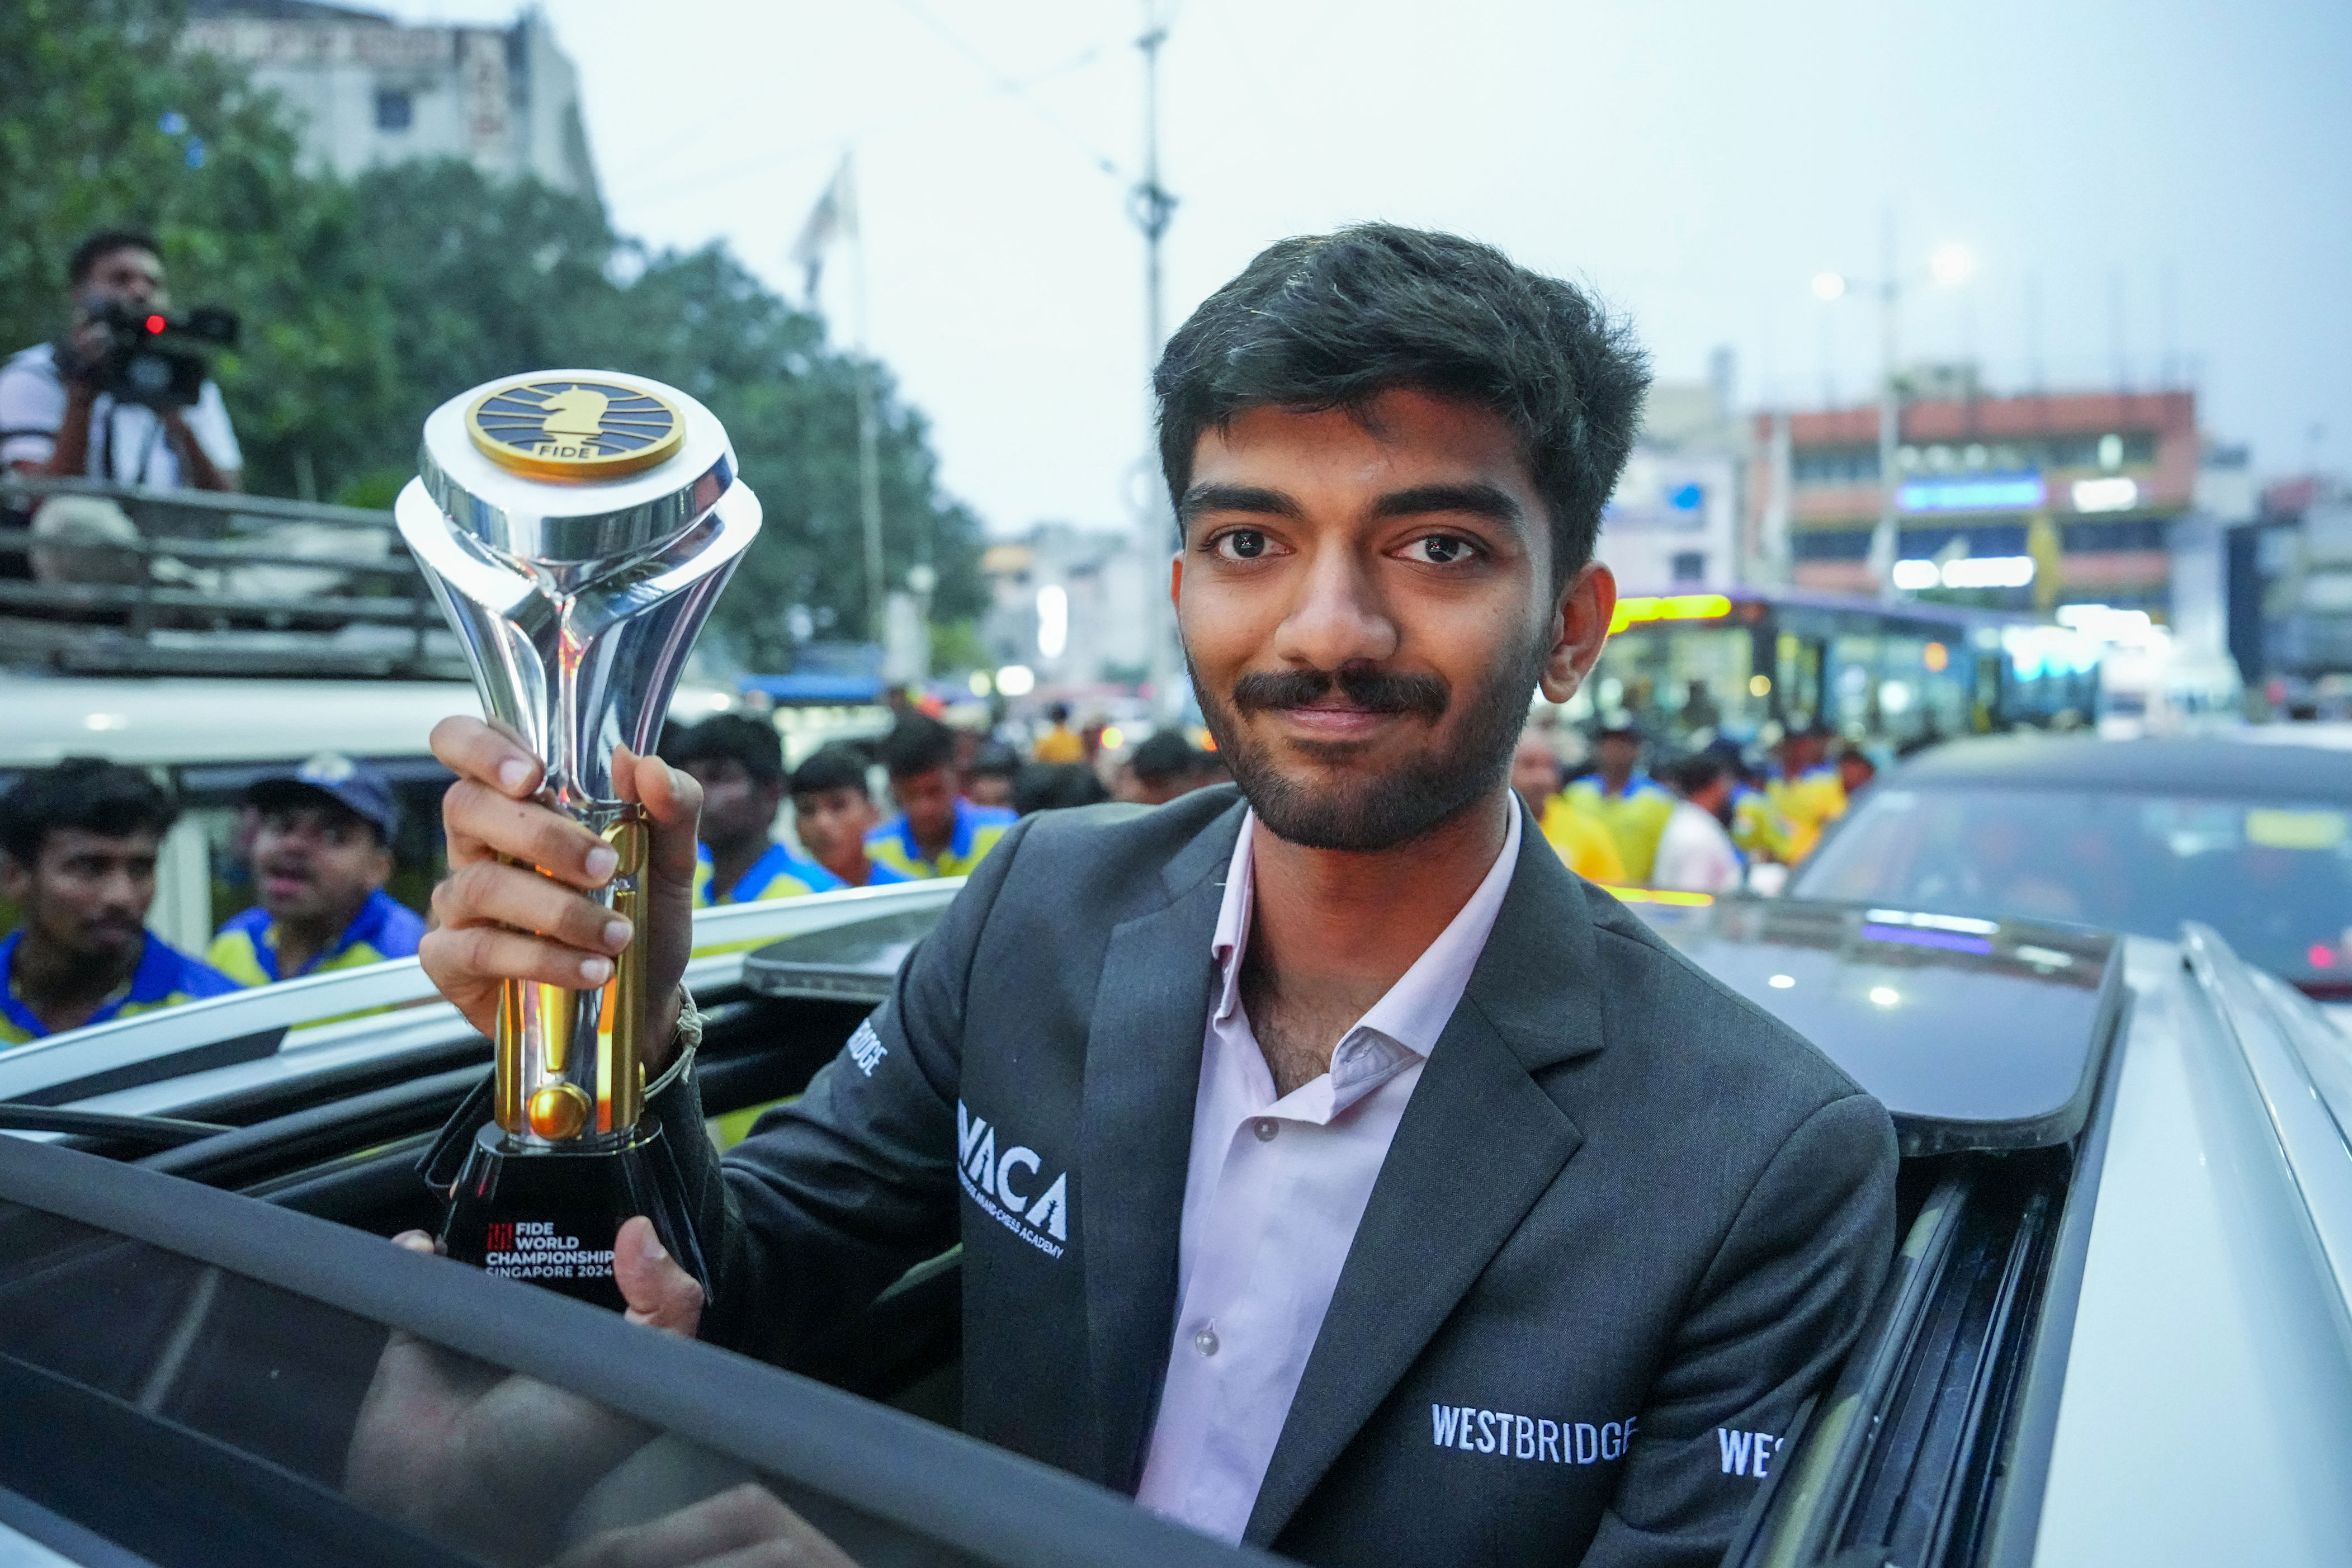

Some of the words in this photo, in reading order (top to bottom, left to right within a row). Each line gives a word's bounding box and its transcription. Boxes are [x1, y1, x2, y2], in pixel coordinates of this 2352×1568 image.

[539, 446, 589, 459] FIDE
[515, 1222, 554, 1236] FIDE
[515, 1236, 579, 1250] WORLD
[1019, 1227, 1064, 1259] ACADEMY
[485, 1250, 615, 1265] CHAMPIONSHIP
[485, 1265, 574, 1278] SINGAPORE
[577, 1264, 613, 1278] 2024
[1432, 1404, 1637, 1464] WESTBRIDGE
